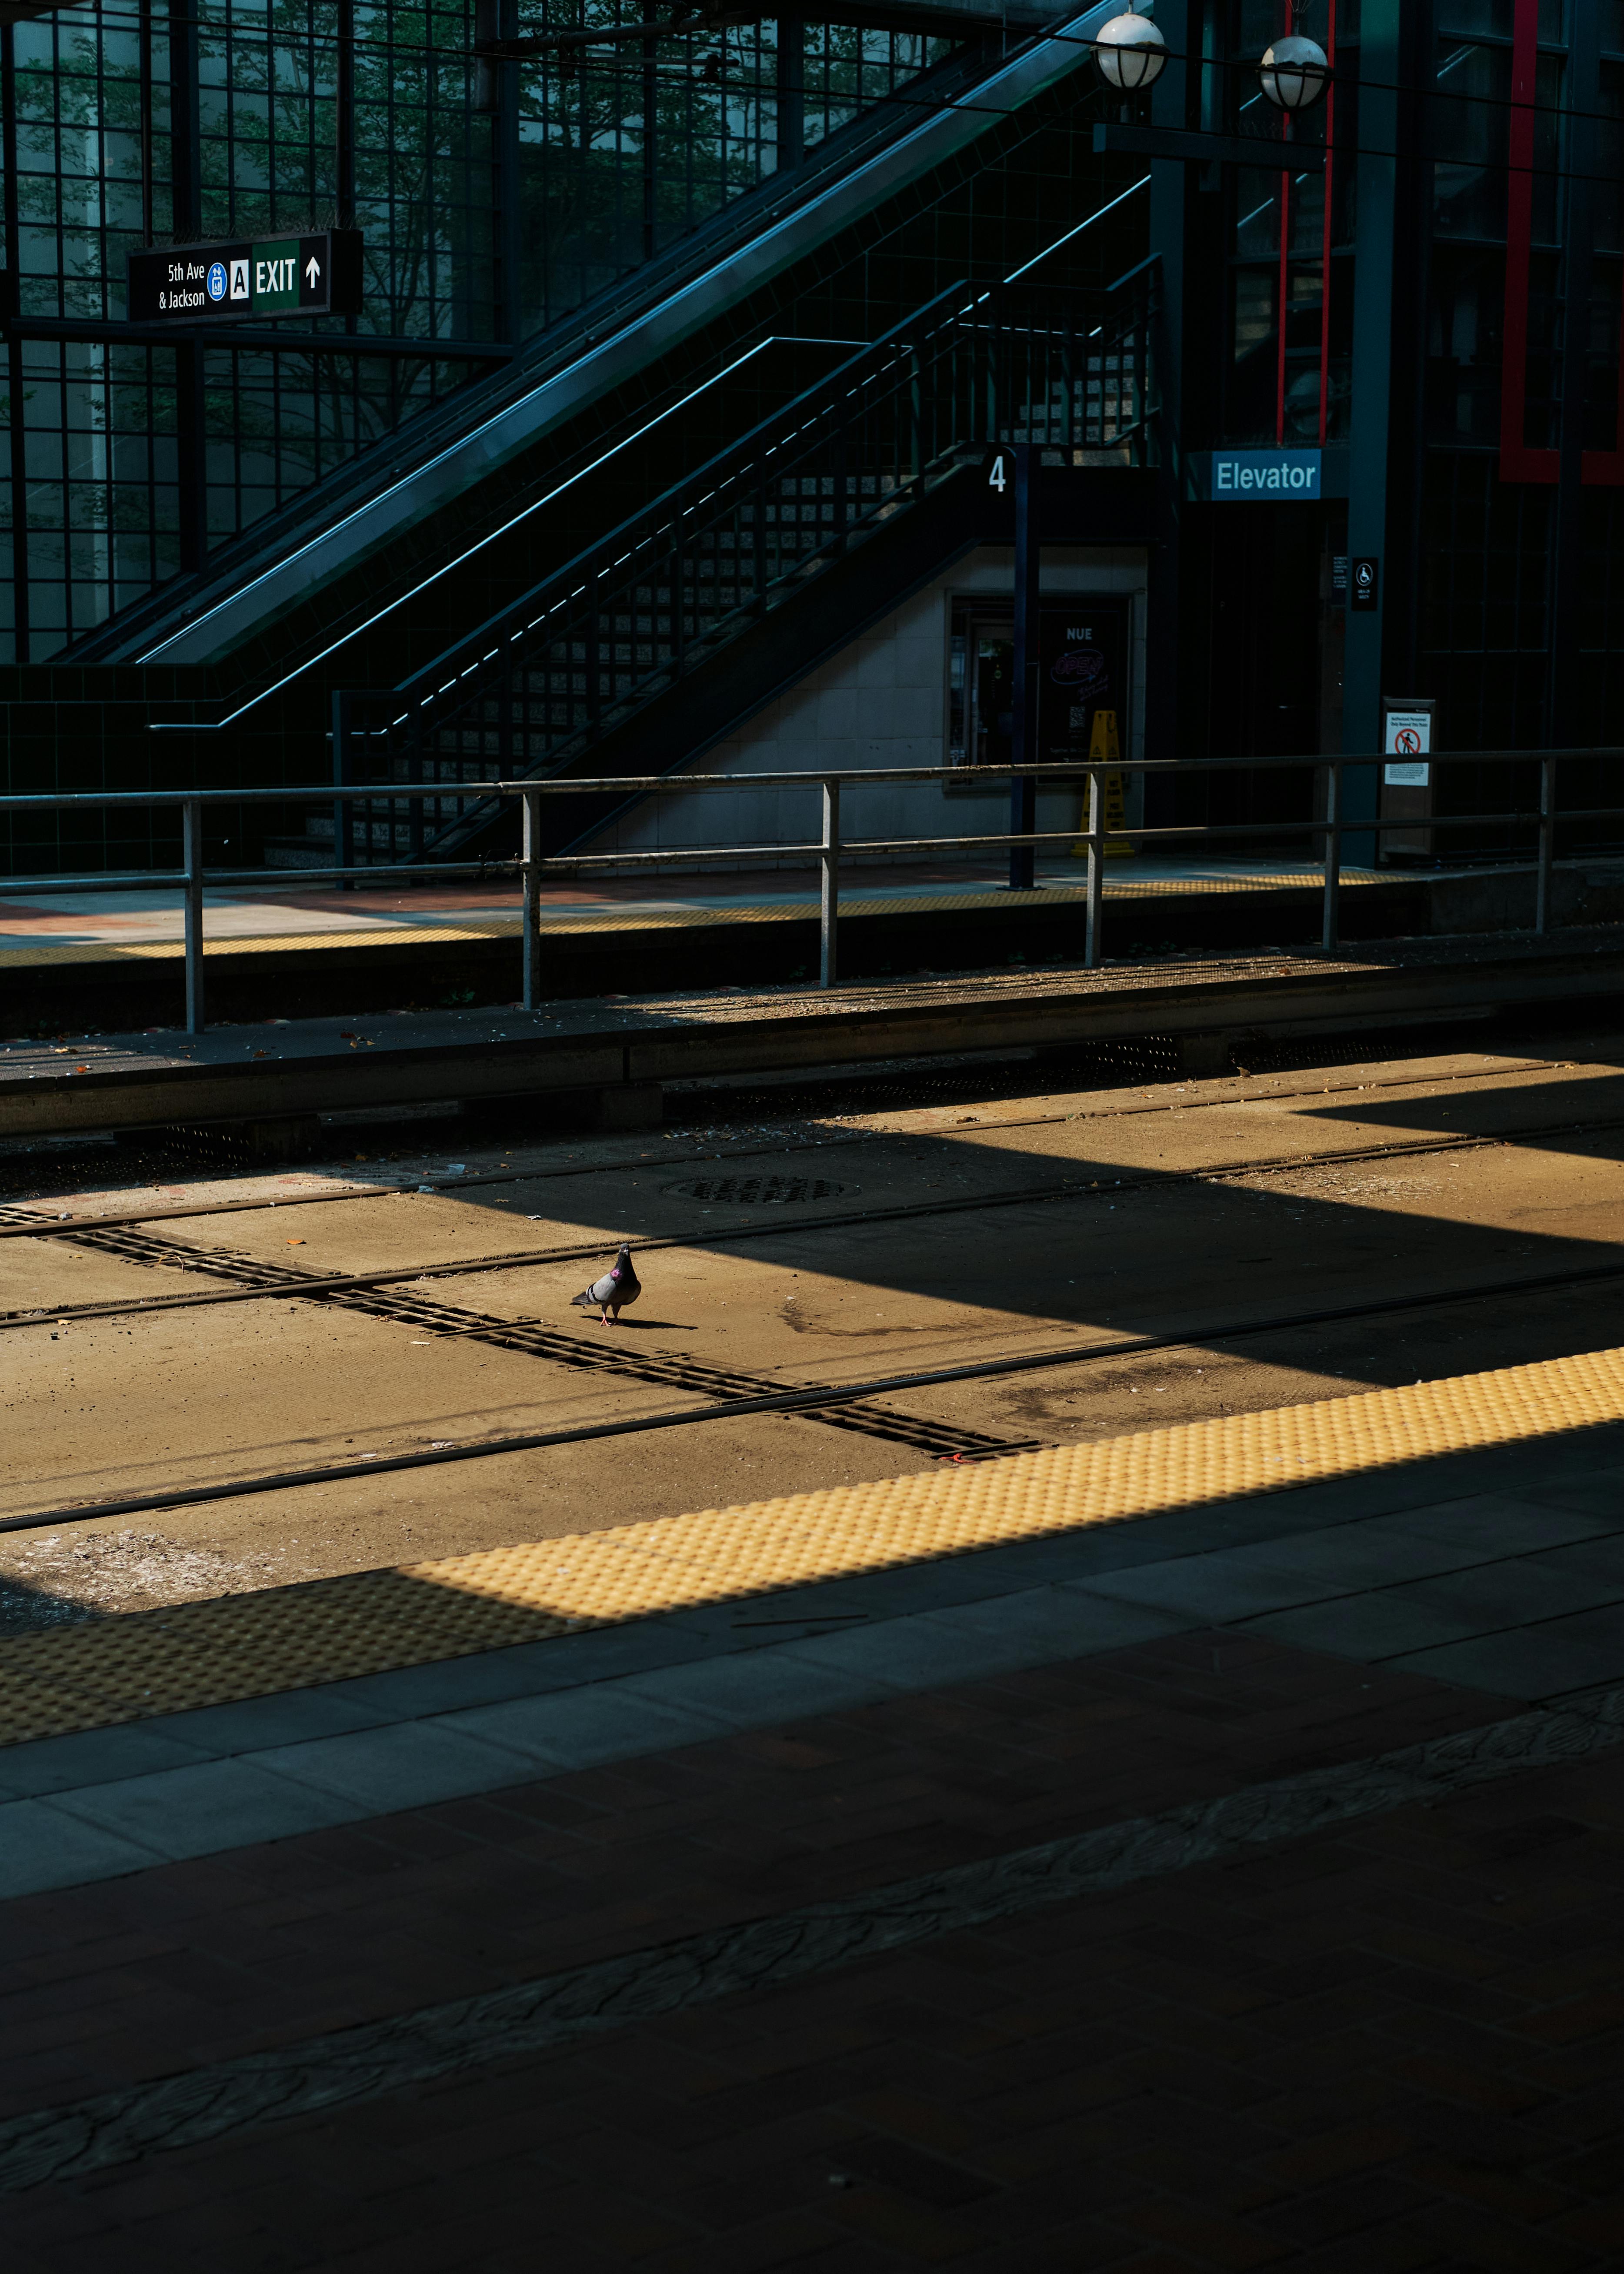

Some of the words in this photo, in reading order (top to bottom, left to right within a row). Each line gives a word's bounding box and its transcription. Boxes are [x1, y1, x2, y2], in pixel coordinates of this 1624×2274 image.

[168, 263, 183, 282] 5th
[186, 262, 205, 280] Ave
[233, 267, 245, 293] A
[256, 258, 296, 294] EXIT
[159, 291, 166, 309] &
[168, 289, 205, 308] Jackson
[988, 455, 1007, 492] 4
[1217, 462, 1316, 490] Elevator
[1066, 628, 1093, 641] NUE
[1055, 656, 1104, 675] OPEN
